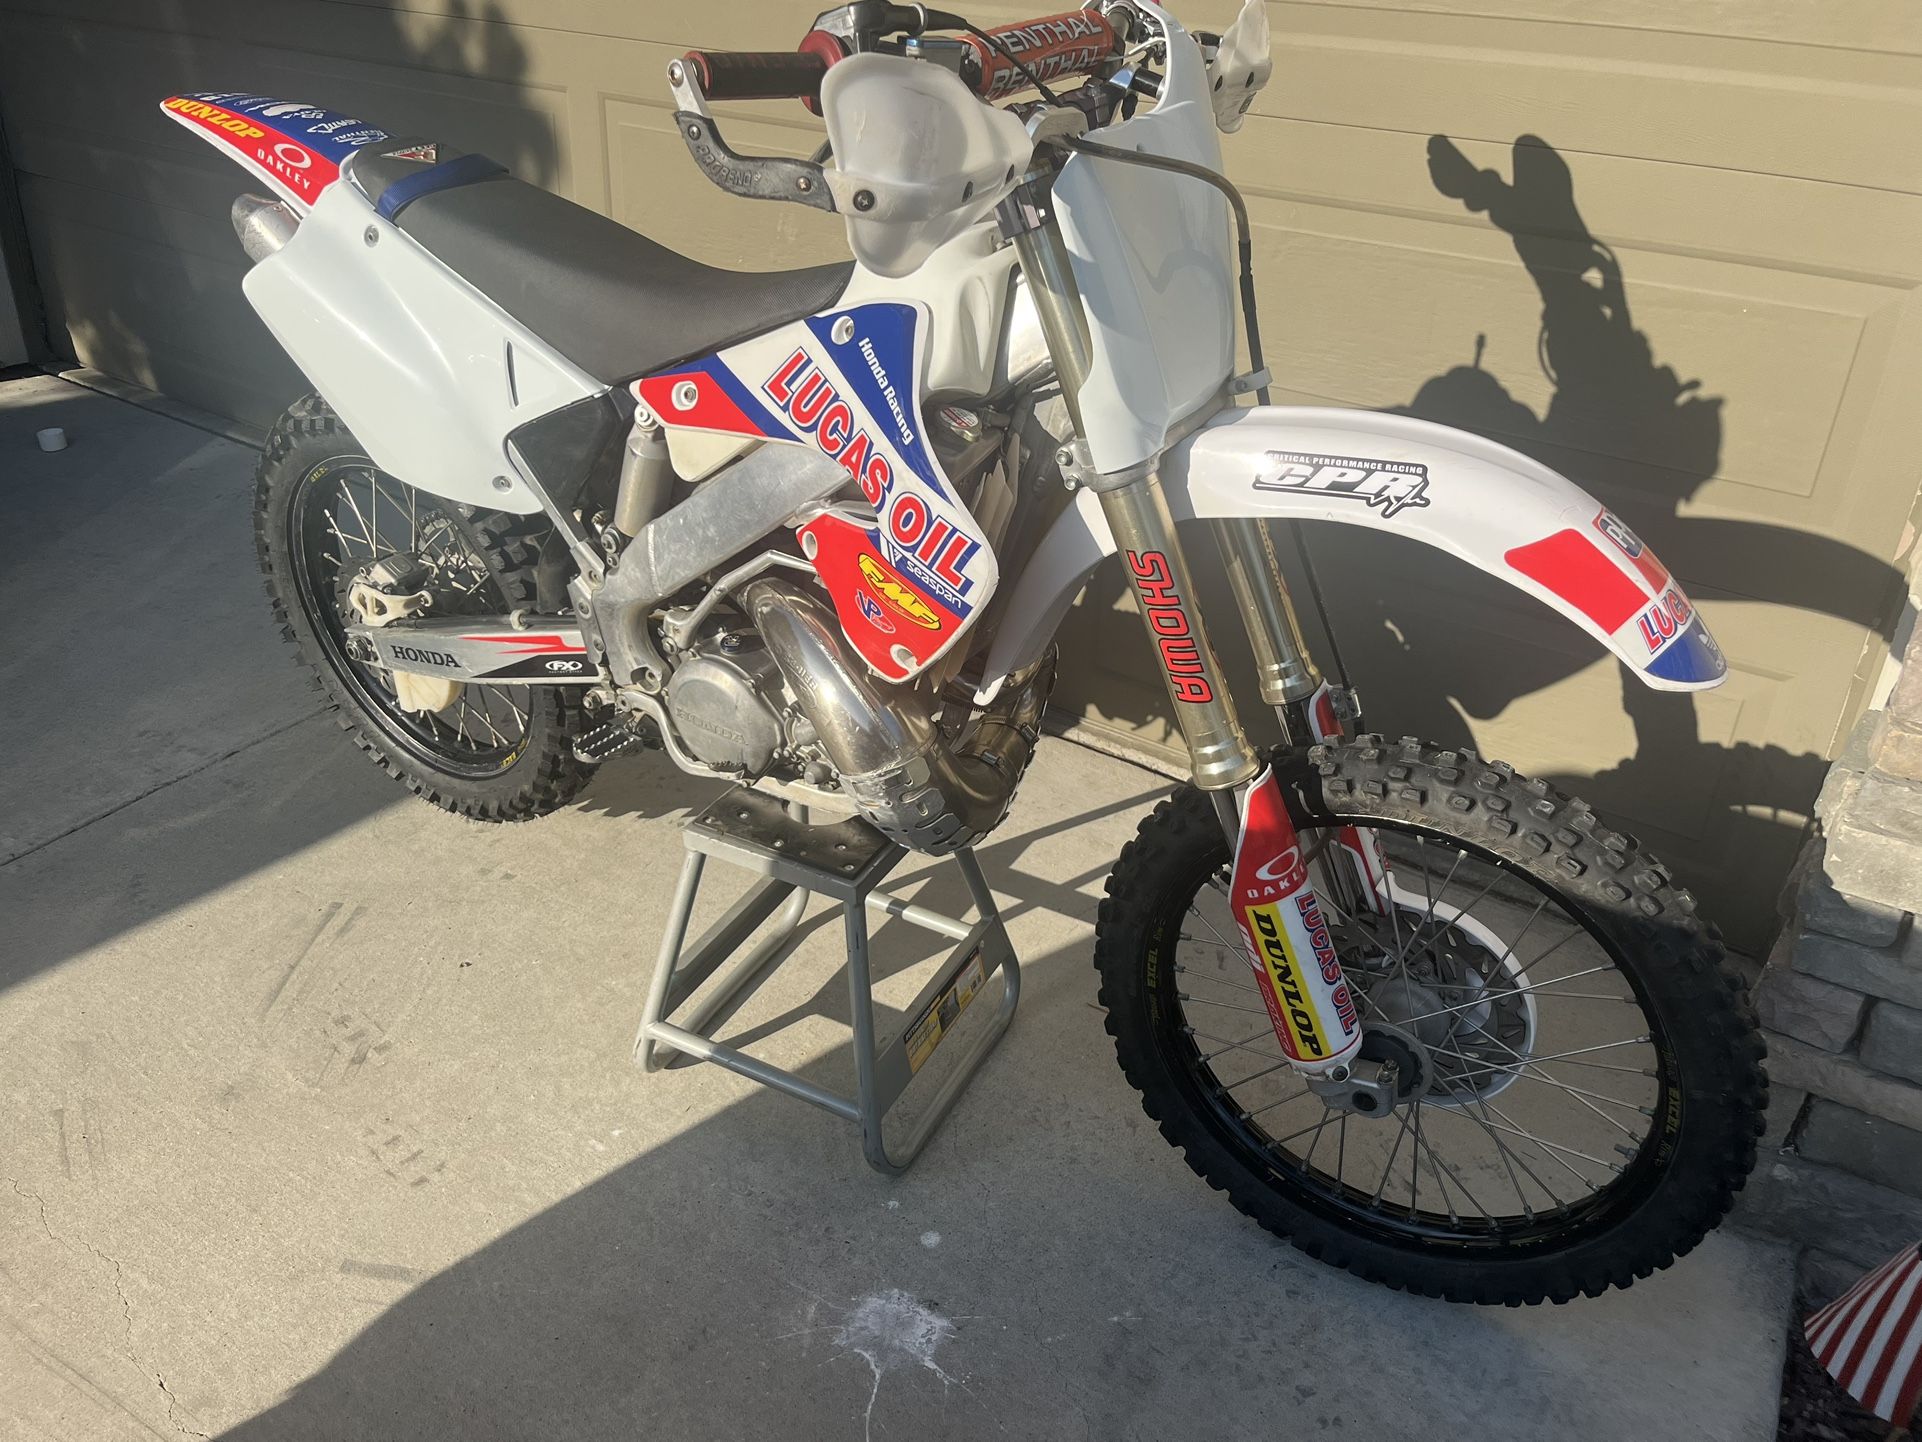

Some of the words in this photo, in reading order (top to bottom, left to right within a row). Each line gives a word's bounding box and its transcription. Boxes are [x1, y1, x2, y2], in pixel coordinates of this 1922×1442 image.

[990, 46, 1099, 91] RENTHAL
[165, 98, 265, 139] DUNLOP
[257, 148, 311, 190] OAKLEY
[858, 337, 889, 390] Honda
[883, 385, 915, 446] Racing
[761, 346, 894, 513] LUCAS
[889, 491, 981, 598] OIL
[1258, 462, 1425, 499] CPR
[1267, 452, 1311, 464] CRITICAL
[1312, 456, 1383, 471] PERFORMANCE
[1385, 464, 1424, 475] RACING
[856, 588, 883, 620] VP
[858, 556, 941, 625] FMF
[905, 559, 963, 609] seaspan
[1126, 549, 1214, 704] SHOWA
[390, 644, 462, 669] HONDA
[1252, 909, 1323, 1057] DUNLOP
[1295, 888, 1344, 985] LUCAS
[1331, 986, 1359, 1036] OIL
